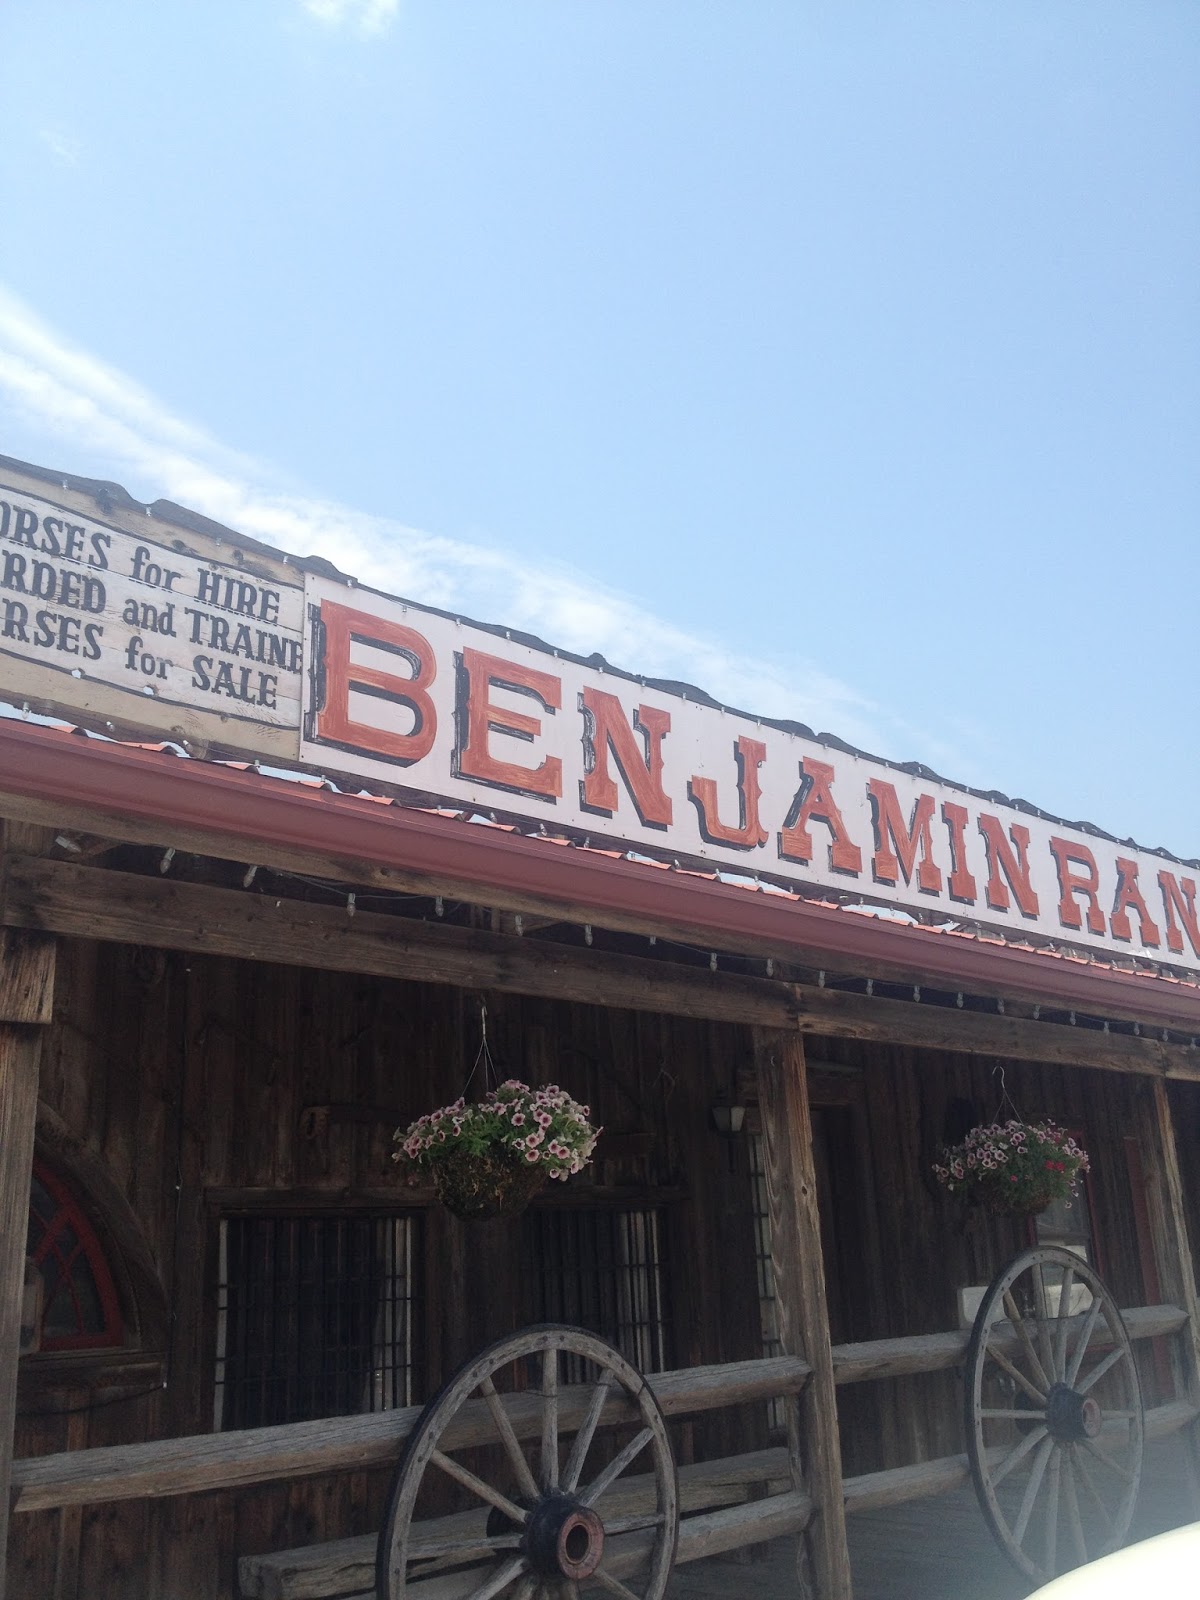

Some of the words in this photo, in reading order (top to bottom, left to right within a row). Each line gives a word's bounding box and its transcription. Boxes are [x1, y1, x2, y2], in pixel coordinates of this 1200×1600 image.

[122, 599, 177, 638] and
[128, 546, 182, 593] for
[194, 568, 280, 626] HIRE
[124, 636, 174, 680] for
[191, 655, 278, 710] SALE
[303, 599, 1040, 921] BENJAMIN
